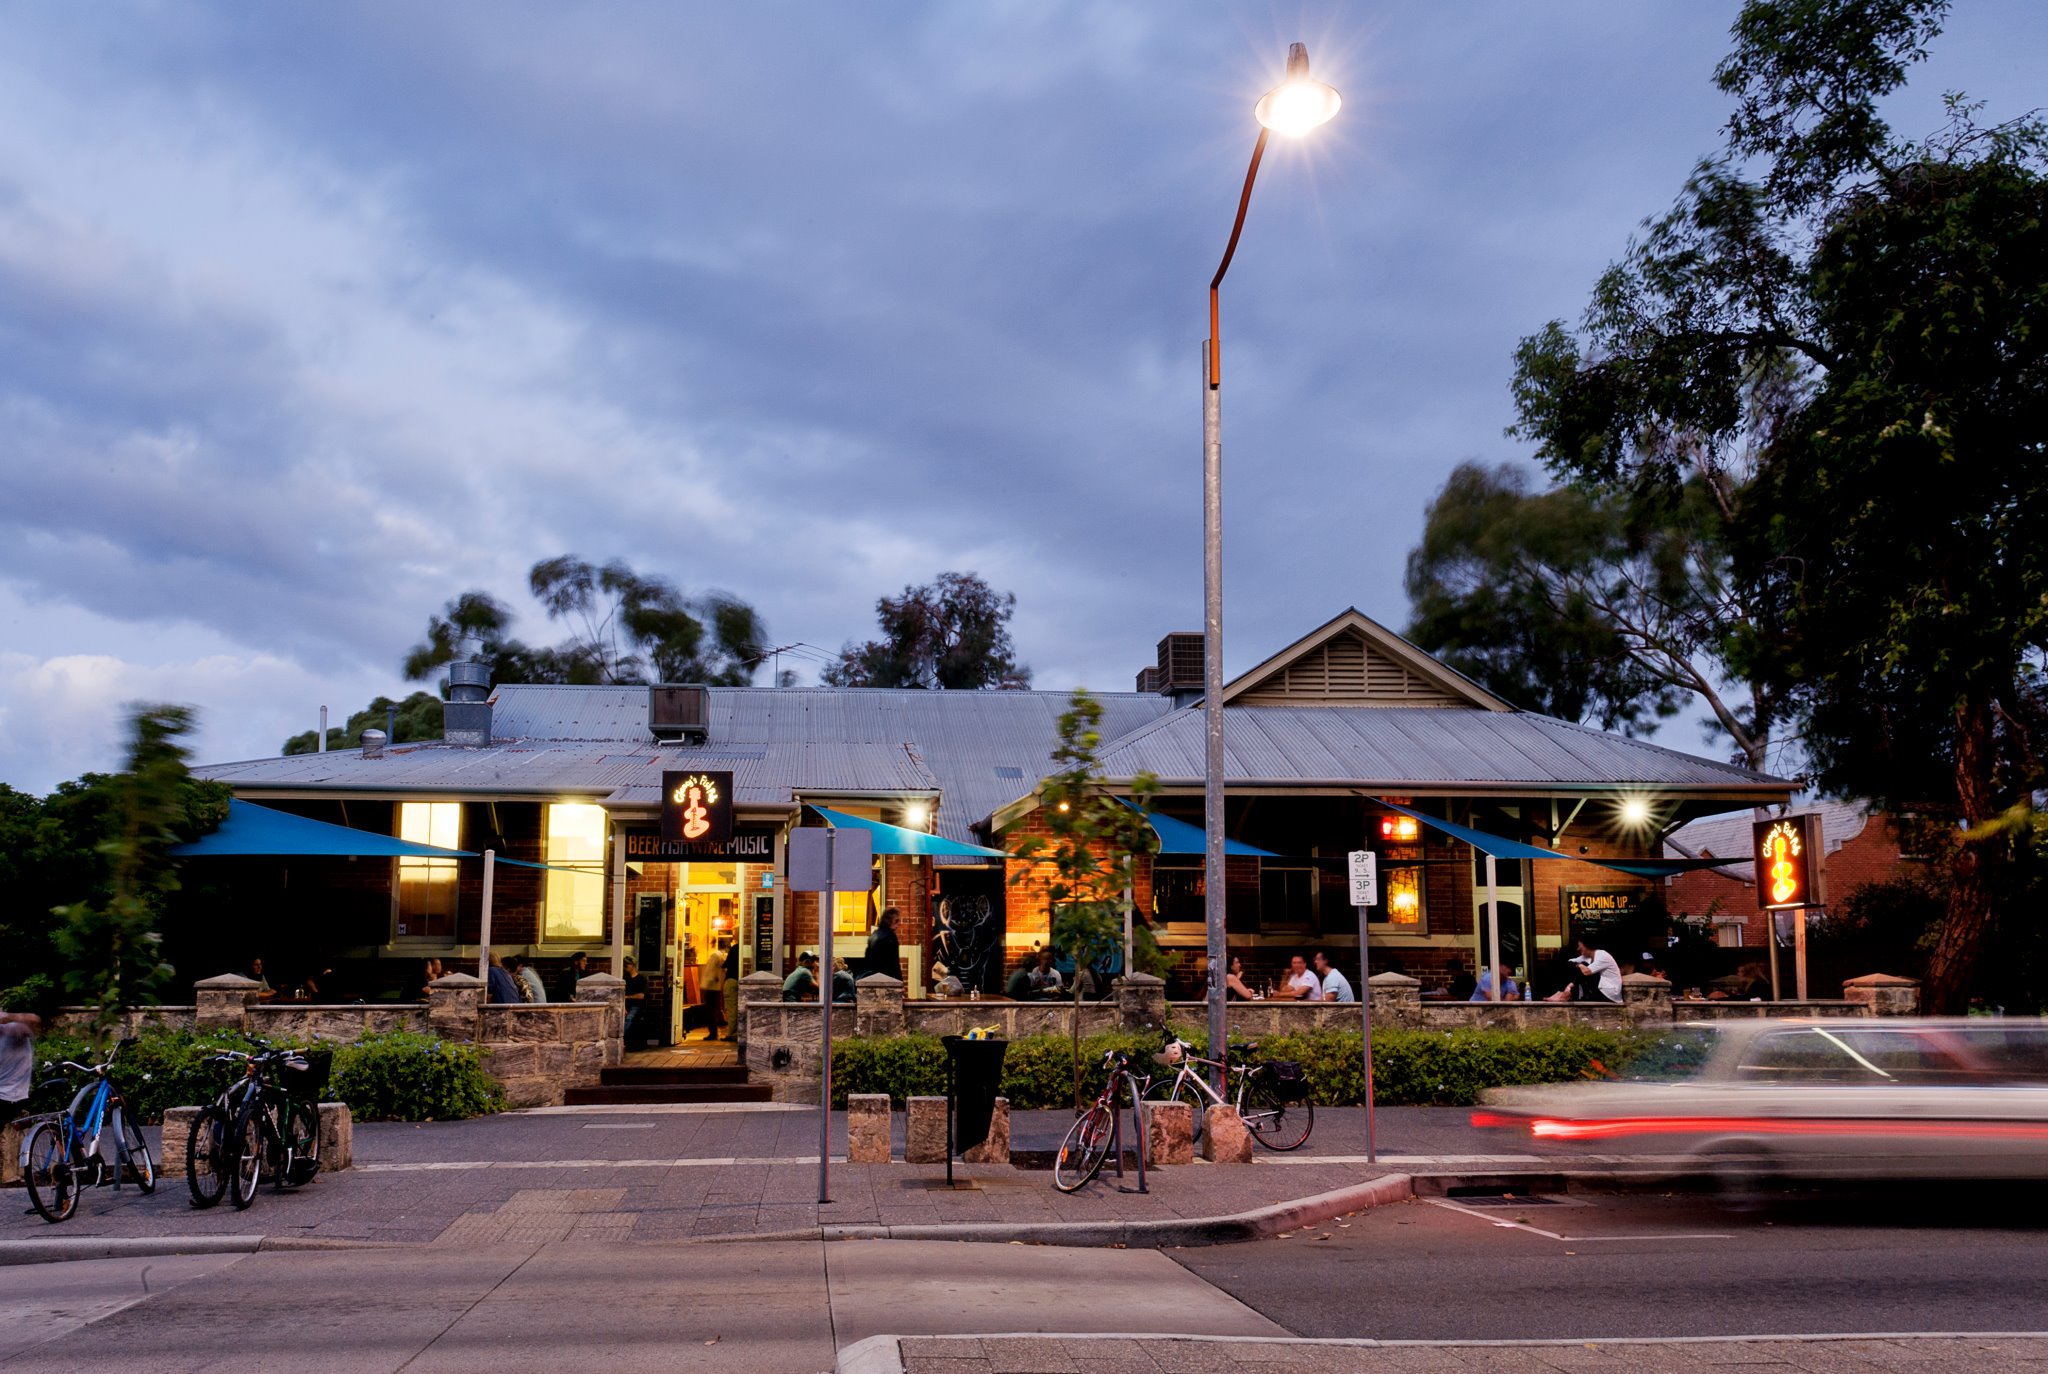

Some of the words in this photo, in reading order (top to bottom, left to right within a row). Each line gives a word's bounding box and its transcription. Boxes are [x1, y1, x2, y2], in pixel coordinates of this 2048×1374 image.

[628, 835, 660, 855] BEER
[726, 835, 769, 855] MUSIC
[1354, 853, 1370, 863] 2P
[1355, 880, 1371, 890] 3P
[1580, 895, 1615, 909] COMING
